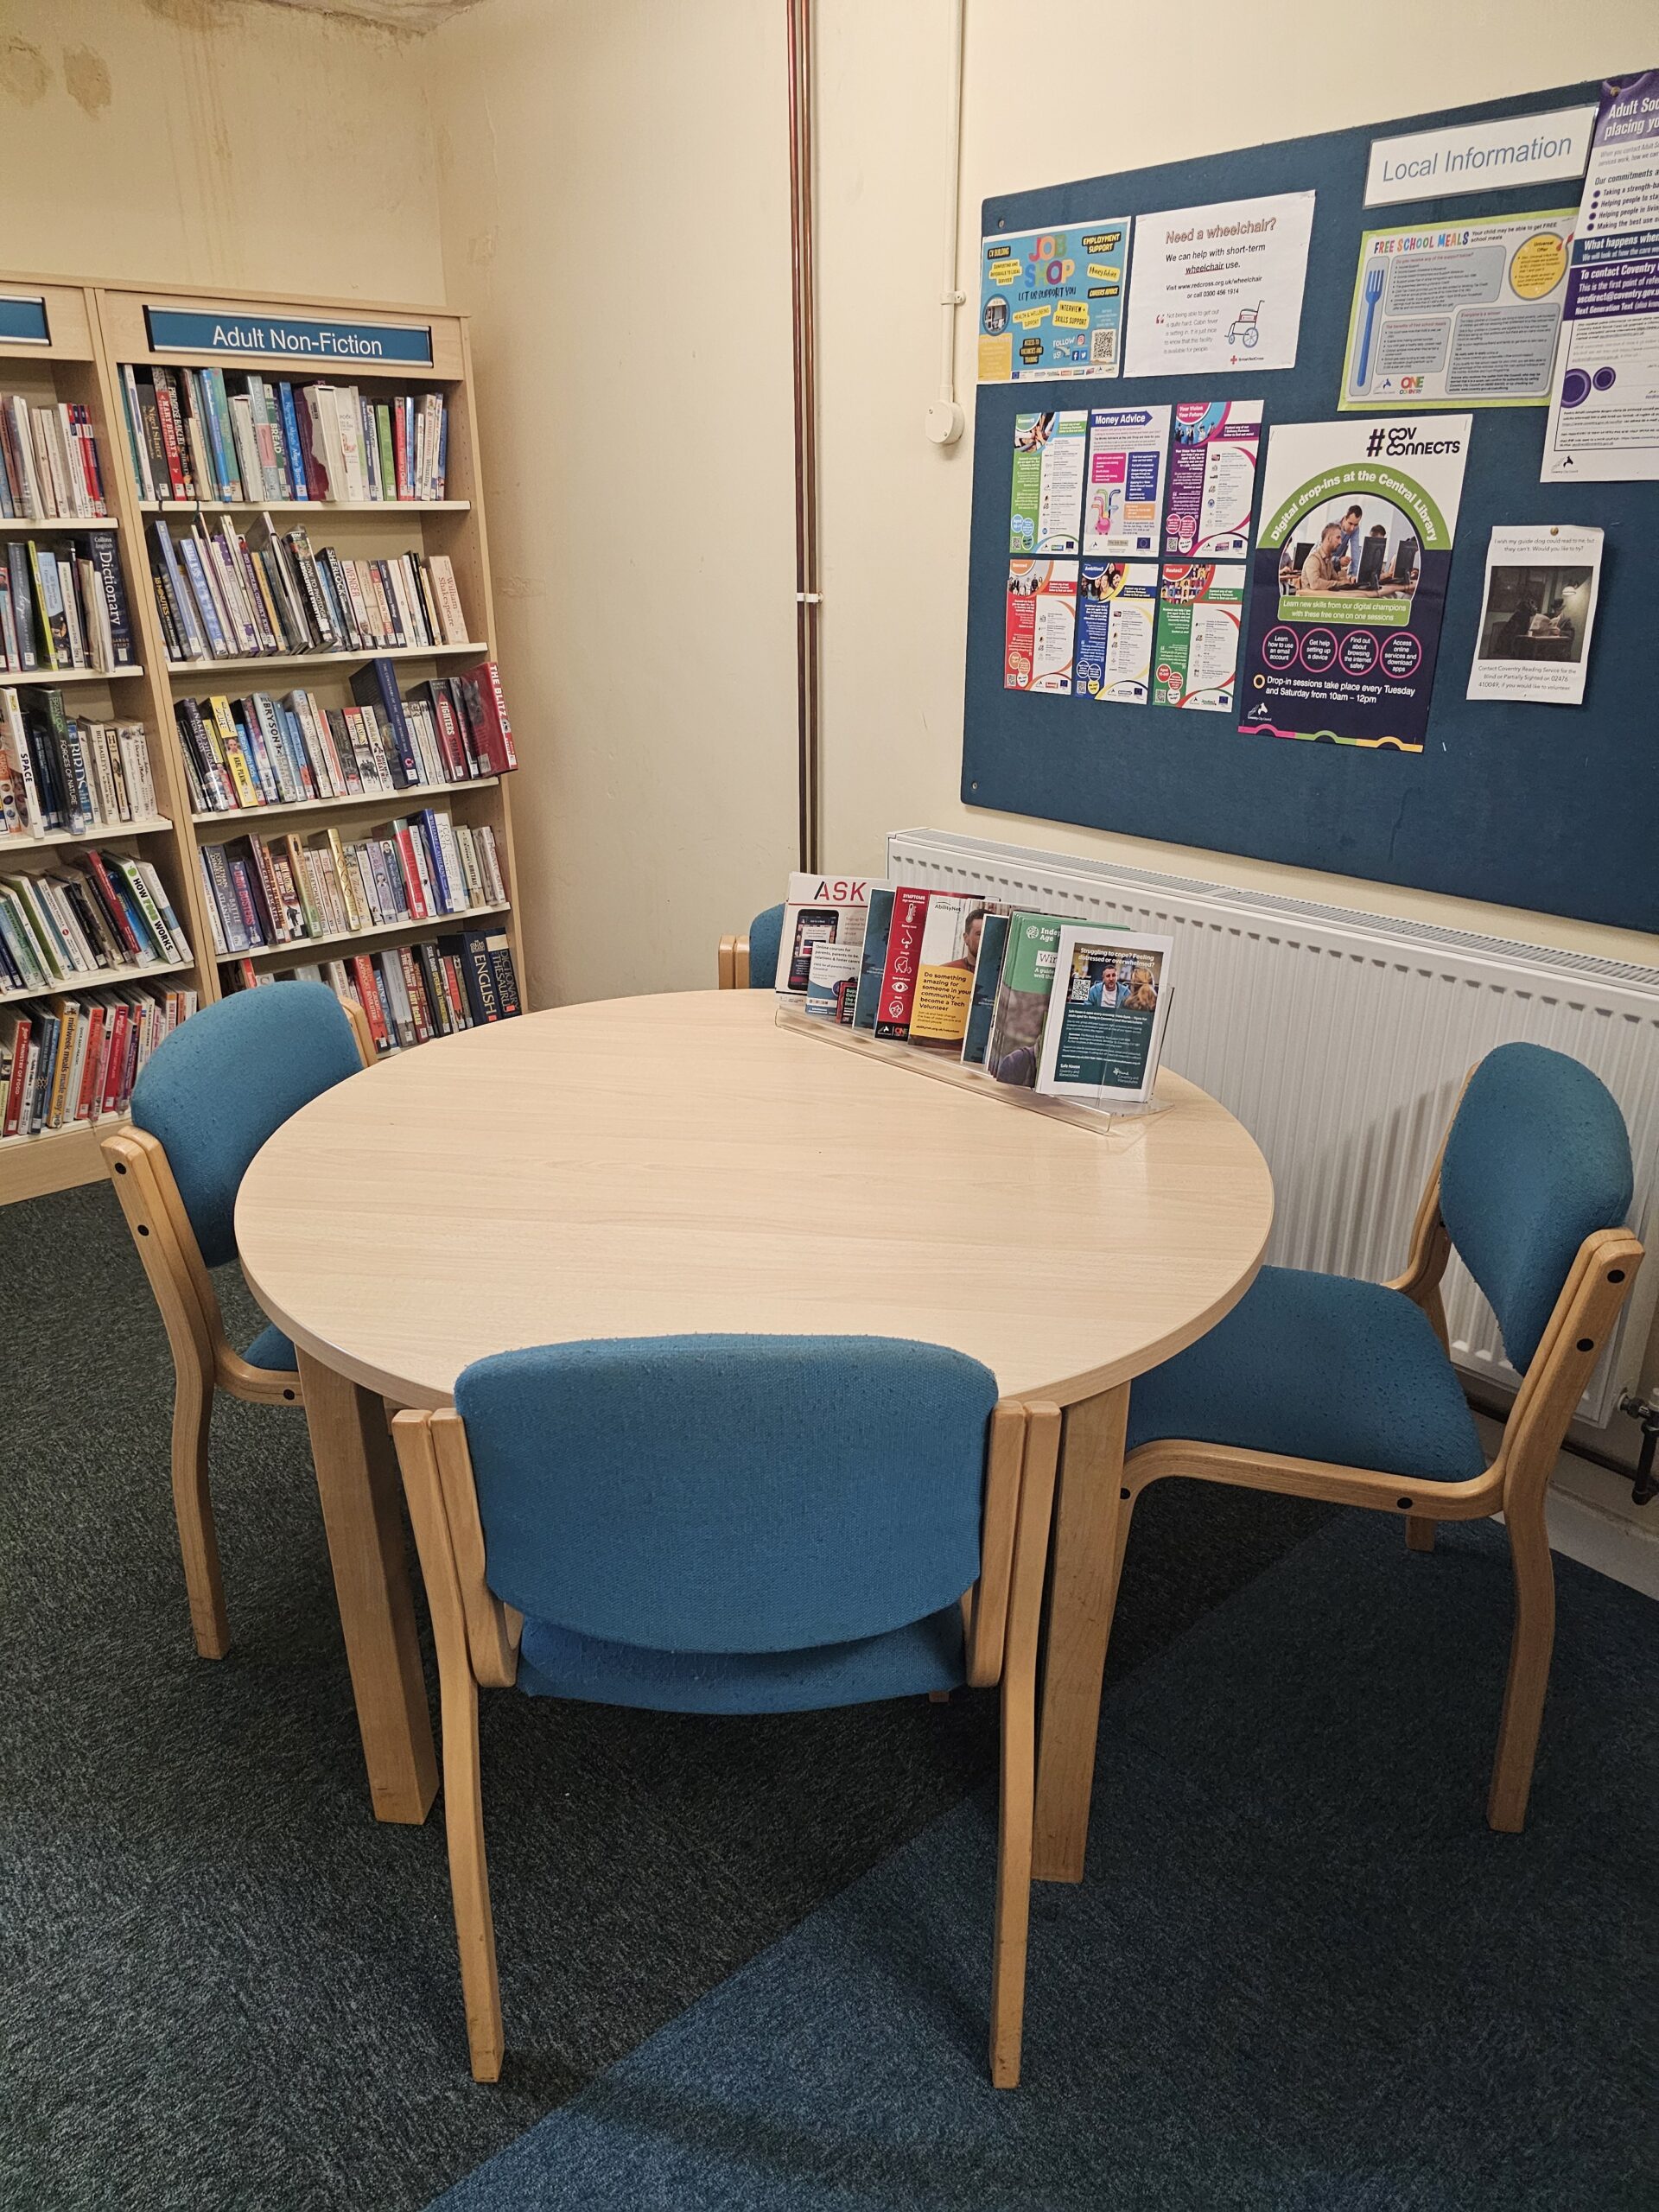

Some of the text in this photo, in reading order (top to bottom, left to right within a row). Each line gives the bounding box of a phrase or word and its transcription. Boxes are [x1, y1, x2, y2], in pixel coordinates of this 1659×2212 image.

[1608, 101, 1639, 118] Adult
[1604, 119, 1645, 140] placing
[1383, 137, 1572, 181] Local Information
[1595, 168, 1652, 186] Our commitments
[1601, 195, 1640, 207] Helping people
[1166, 217, 1276, 245] Need a wheelchair?
[1597, 220, 1618, 230] Making
[1028, 234, 1067, 262] JOB
[1083, 233, 1121, 245] EMPLOYMENT
[1088, 243, 1113, 253] SUPPORT
[1374, 232, 1469, 254] FREE SCHOOL MEALS
[1584, 235, 1637, 251] What happens
[1166, 254, 1176, 263] We
[1192, 250, 1207, 259] help
[1210, 248, 1224, 257] with
[1227, 244, 1266, 256] short-term
[1024, 259, 1075, 287] SHOP
[1185, 262, 1224, 275] wheelchair
[1580, 263, 1656, 279] To contact Coventry
[1019, 286, 1077, 302] LET SUPPORT YOU
[1178, 276, 1262, 289] www.redcross.org.uk/wheelchair
[1590, 304, 1619, 314] Generation
[213, 326, 383, 355] Adult Non-Fiction
[1053, 336, 1075, 346] FOLLOW
[1402, 376, 1424, 389] ONE
[146, 404, 158, 430] Nigel
[152, 431, 163, 460] Slater
[162, 400, 178, 458] MARY BERRY'S
[1095, 413, 1146, 425] Money Advice
[270, 423, 283, 454] BREAD
[1388, 427, 1417, 440] COV
[1386, 441, 1460, 455] CONNECTS
[1270, 470, 1437, 542] Digital drop-ins at the Central Library
[327, 549, 346, 596] SHERLOCK
[346, 567, 360, 598] WENGER
[99, 551, 120, 626] Dictionary
[155, 584, 171, 616] MINUTES
[374, 582, 386, 606] SEASON
[436, 575, 457, 627] Shakespeare
[445, 576, 460, 610] William
[1372, 604, 1406, 613] champions
[490, 665, 506, 717] THE BLITZ
[1266, 687, 1376, 703] and Saturday from 10am 12pm
[1268, 677, 1291, 686] Drop-in
[1294, 678, 1322, 688] sessions
[1324, 681, 1339, 690] take
[1362, 685, 1382, 694] every
[1383, 685, 1415, 696] Tuesday
[194, 711, 207, 740] NAKED
[262, 702, 282, 744] BRYSON
[440, 702, 454, 735] FIGHTERS
[20, 753, 32, 783] SPACE
[59, 739, 78, 805] FORCES NATURE
[214, 852, 228, 888] JONATHAN
[233, 869, 256, 926] DAM BUSTERS
[814, 881, 867, 901] ASK
[132, 877, 175, 952] HOW WORKS
[217, 891, 232, 927] ATLANTIC
[229, 898, 240, 924] BATTLE
[268, 893, 279, 922] ESCAPES
[935, 903, 961, 912] AbilityNet
[1081, 947, 1108, 957] Struggling
[1133, 953, 1154, 962] Feeling
[1112, 959, 1154, 968] overwhelmed?
[473, 954, 497, 1014] ENGLISH
[499, 950, 520, 1010] DICTIONARY
[934, 973, 966, 982] something
[951, 999, 965, 1007] Tech
[17, 1043, 26, 1069] MINISTRY
[54, 1017, 75, 1112] midweek meals made easy
